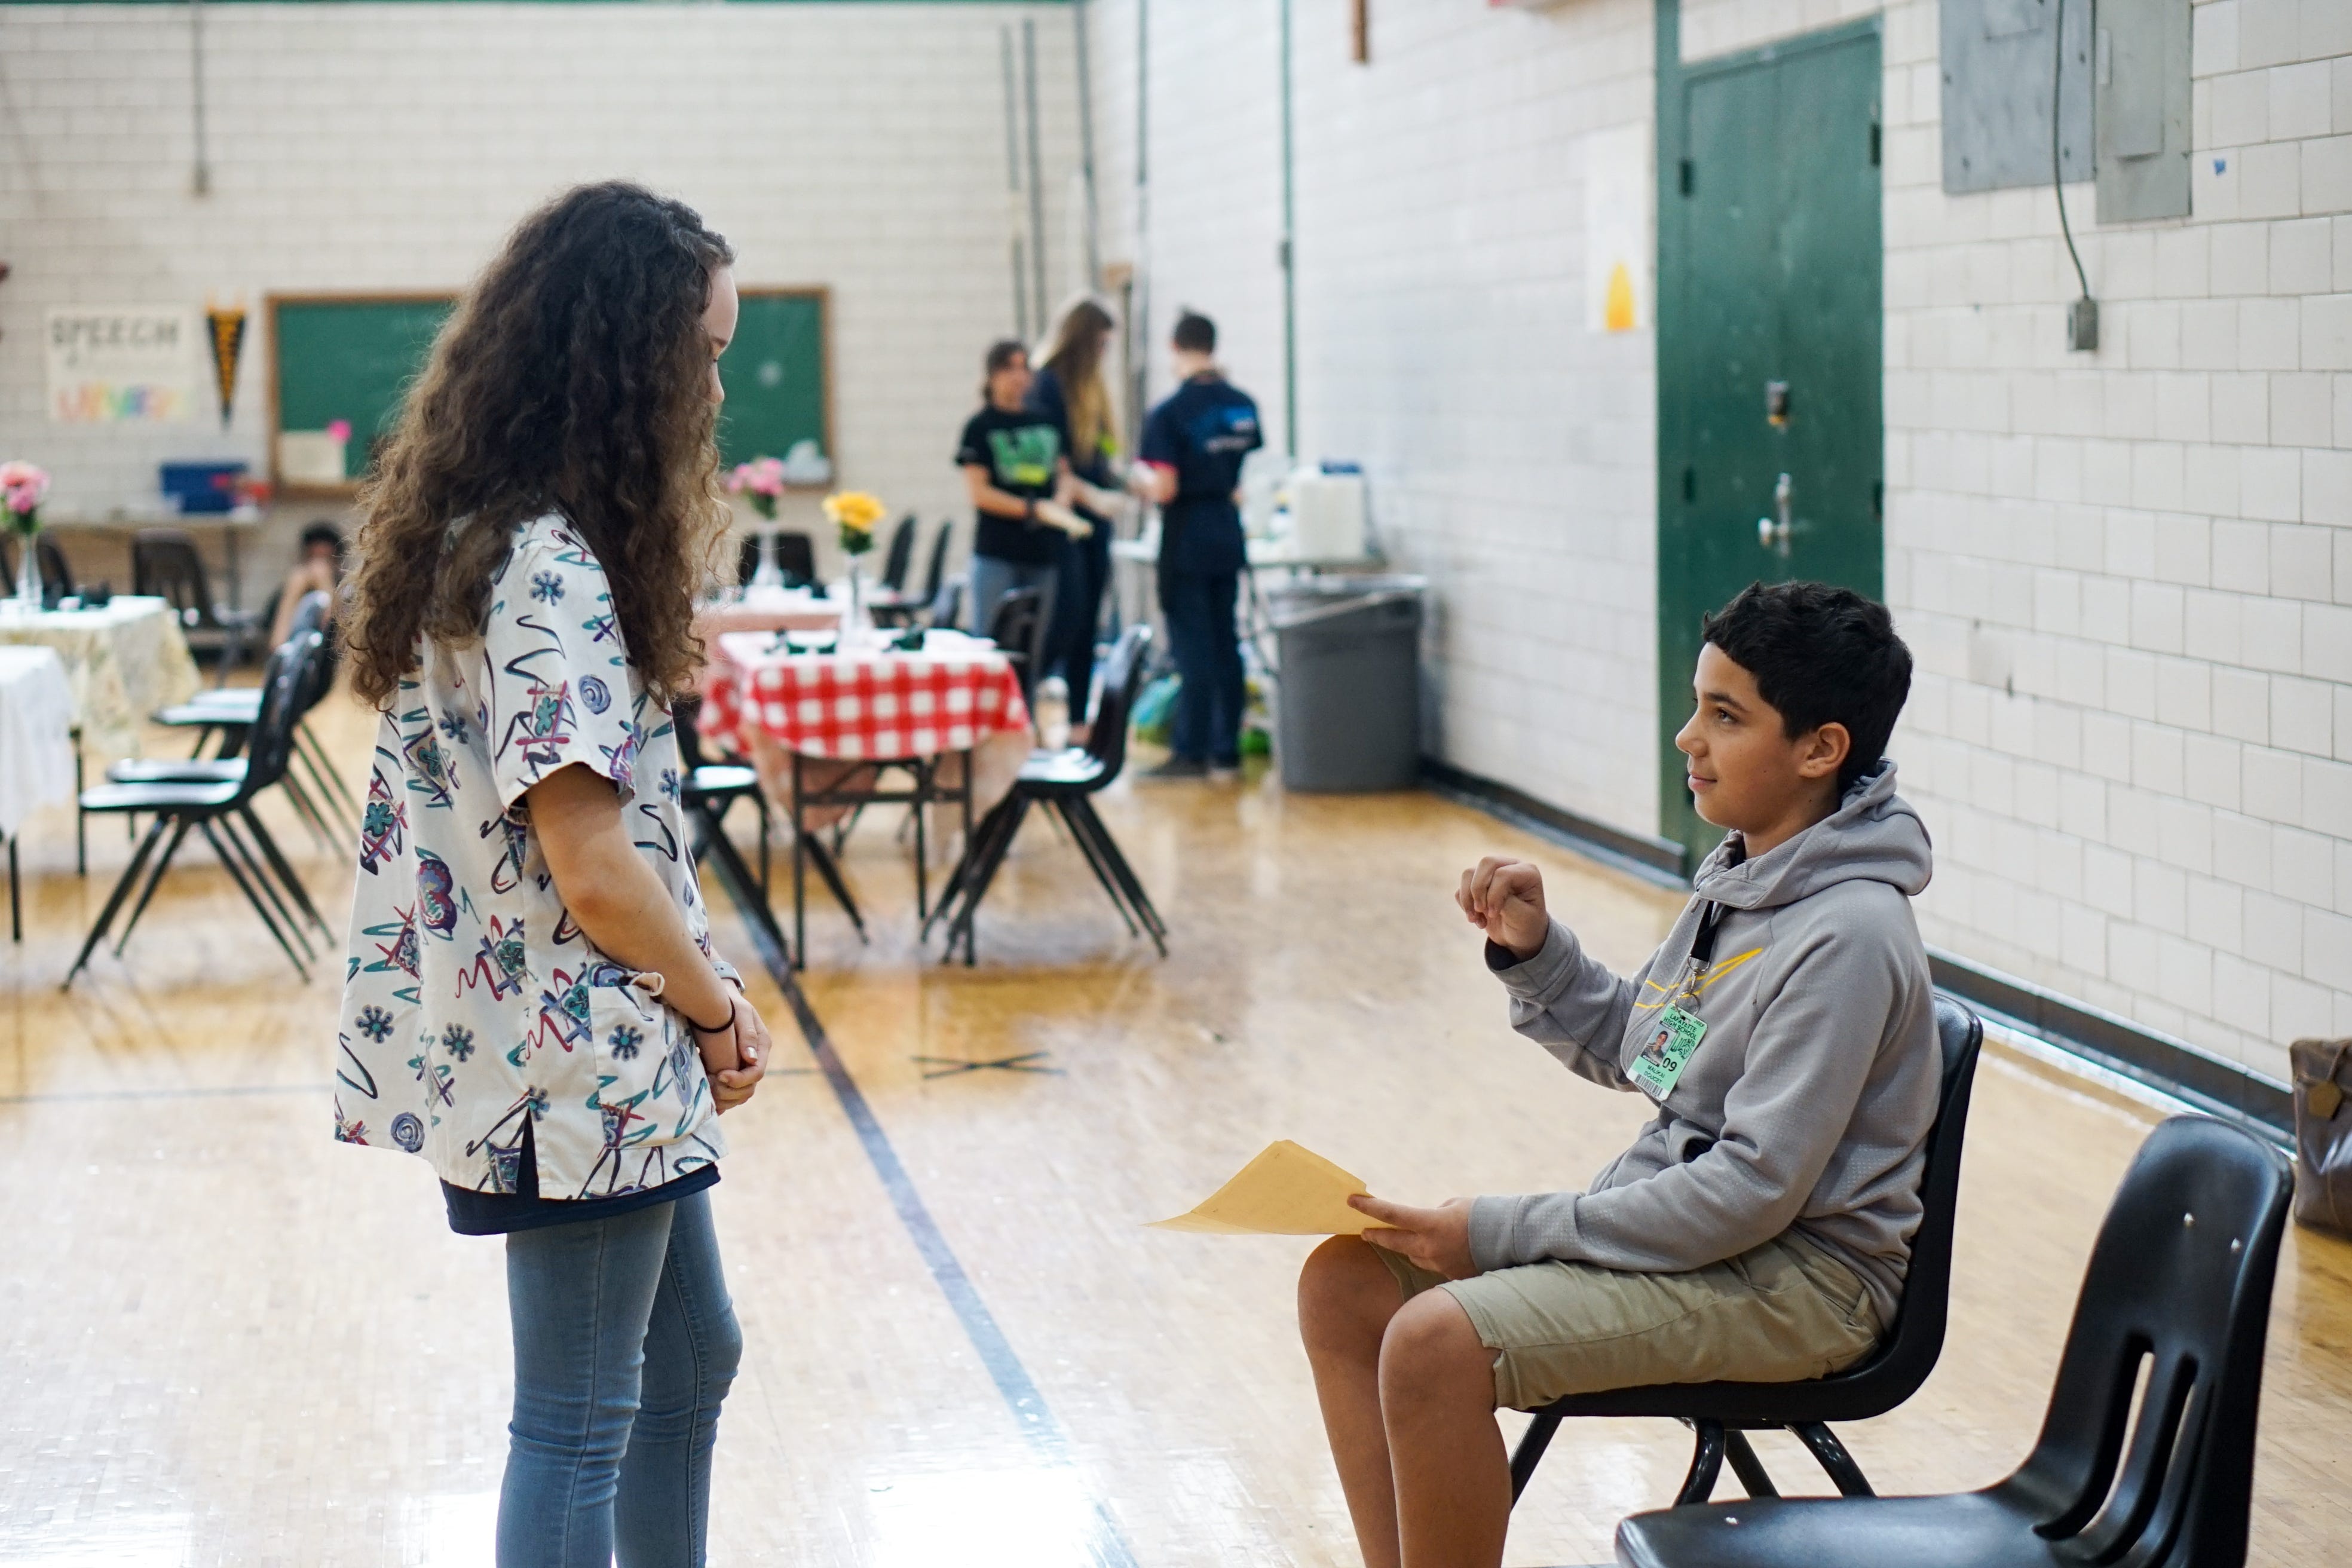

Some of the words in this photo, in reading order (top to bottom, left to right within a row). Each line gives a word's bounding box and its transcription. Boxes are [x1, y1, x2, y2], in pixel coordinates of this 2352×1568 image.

[1663, 1016, 1677, 1027] HIGH
[1677, 1025, 1696, 1040] SCHOOL
[1670, 1013, 1697, 1033] LAFAYETTE
[1662, 1057, 1677, 1071] 09
